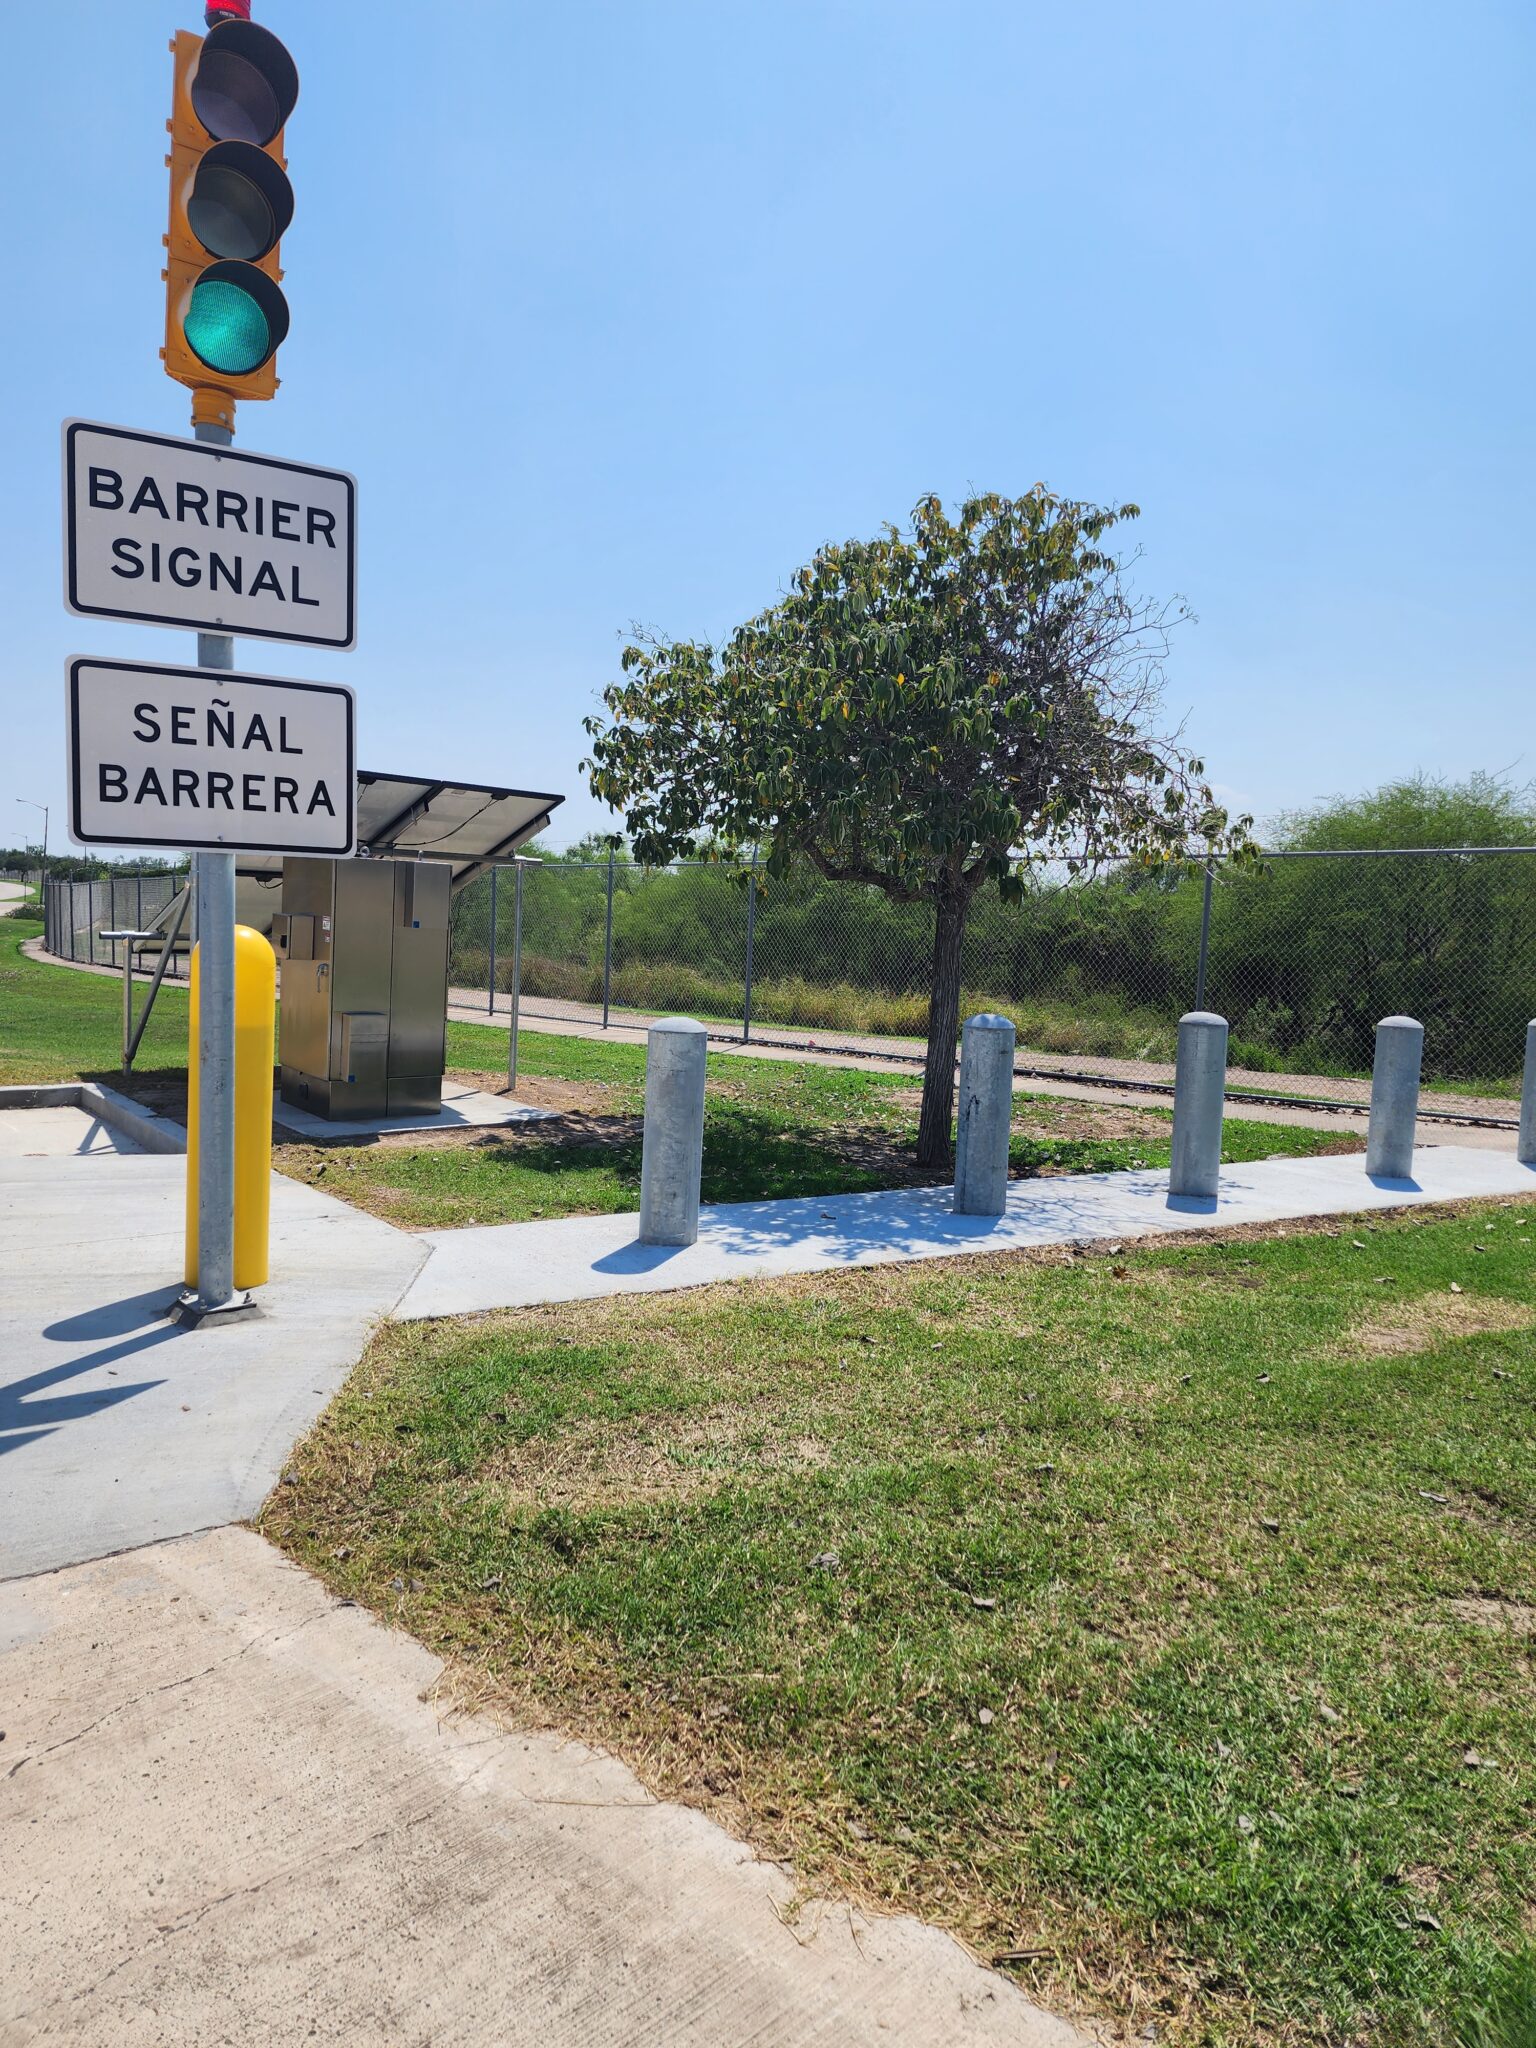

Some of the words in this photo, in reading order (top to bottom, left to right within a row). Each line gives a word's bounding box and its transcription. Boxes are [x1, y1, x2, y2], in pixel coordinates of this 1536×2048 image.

[88, 466, 337, 549] BARRIER
[110, 537, 321, 607] SIGNAL
[132, 698, 304, 755] SEÑAL
[98, 763, 336, 817] BARRERA
